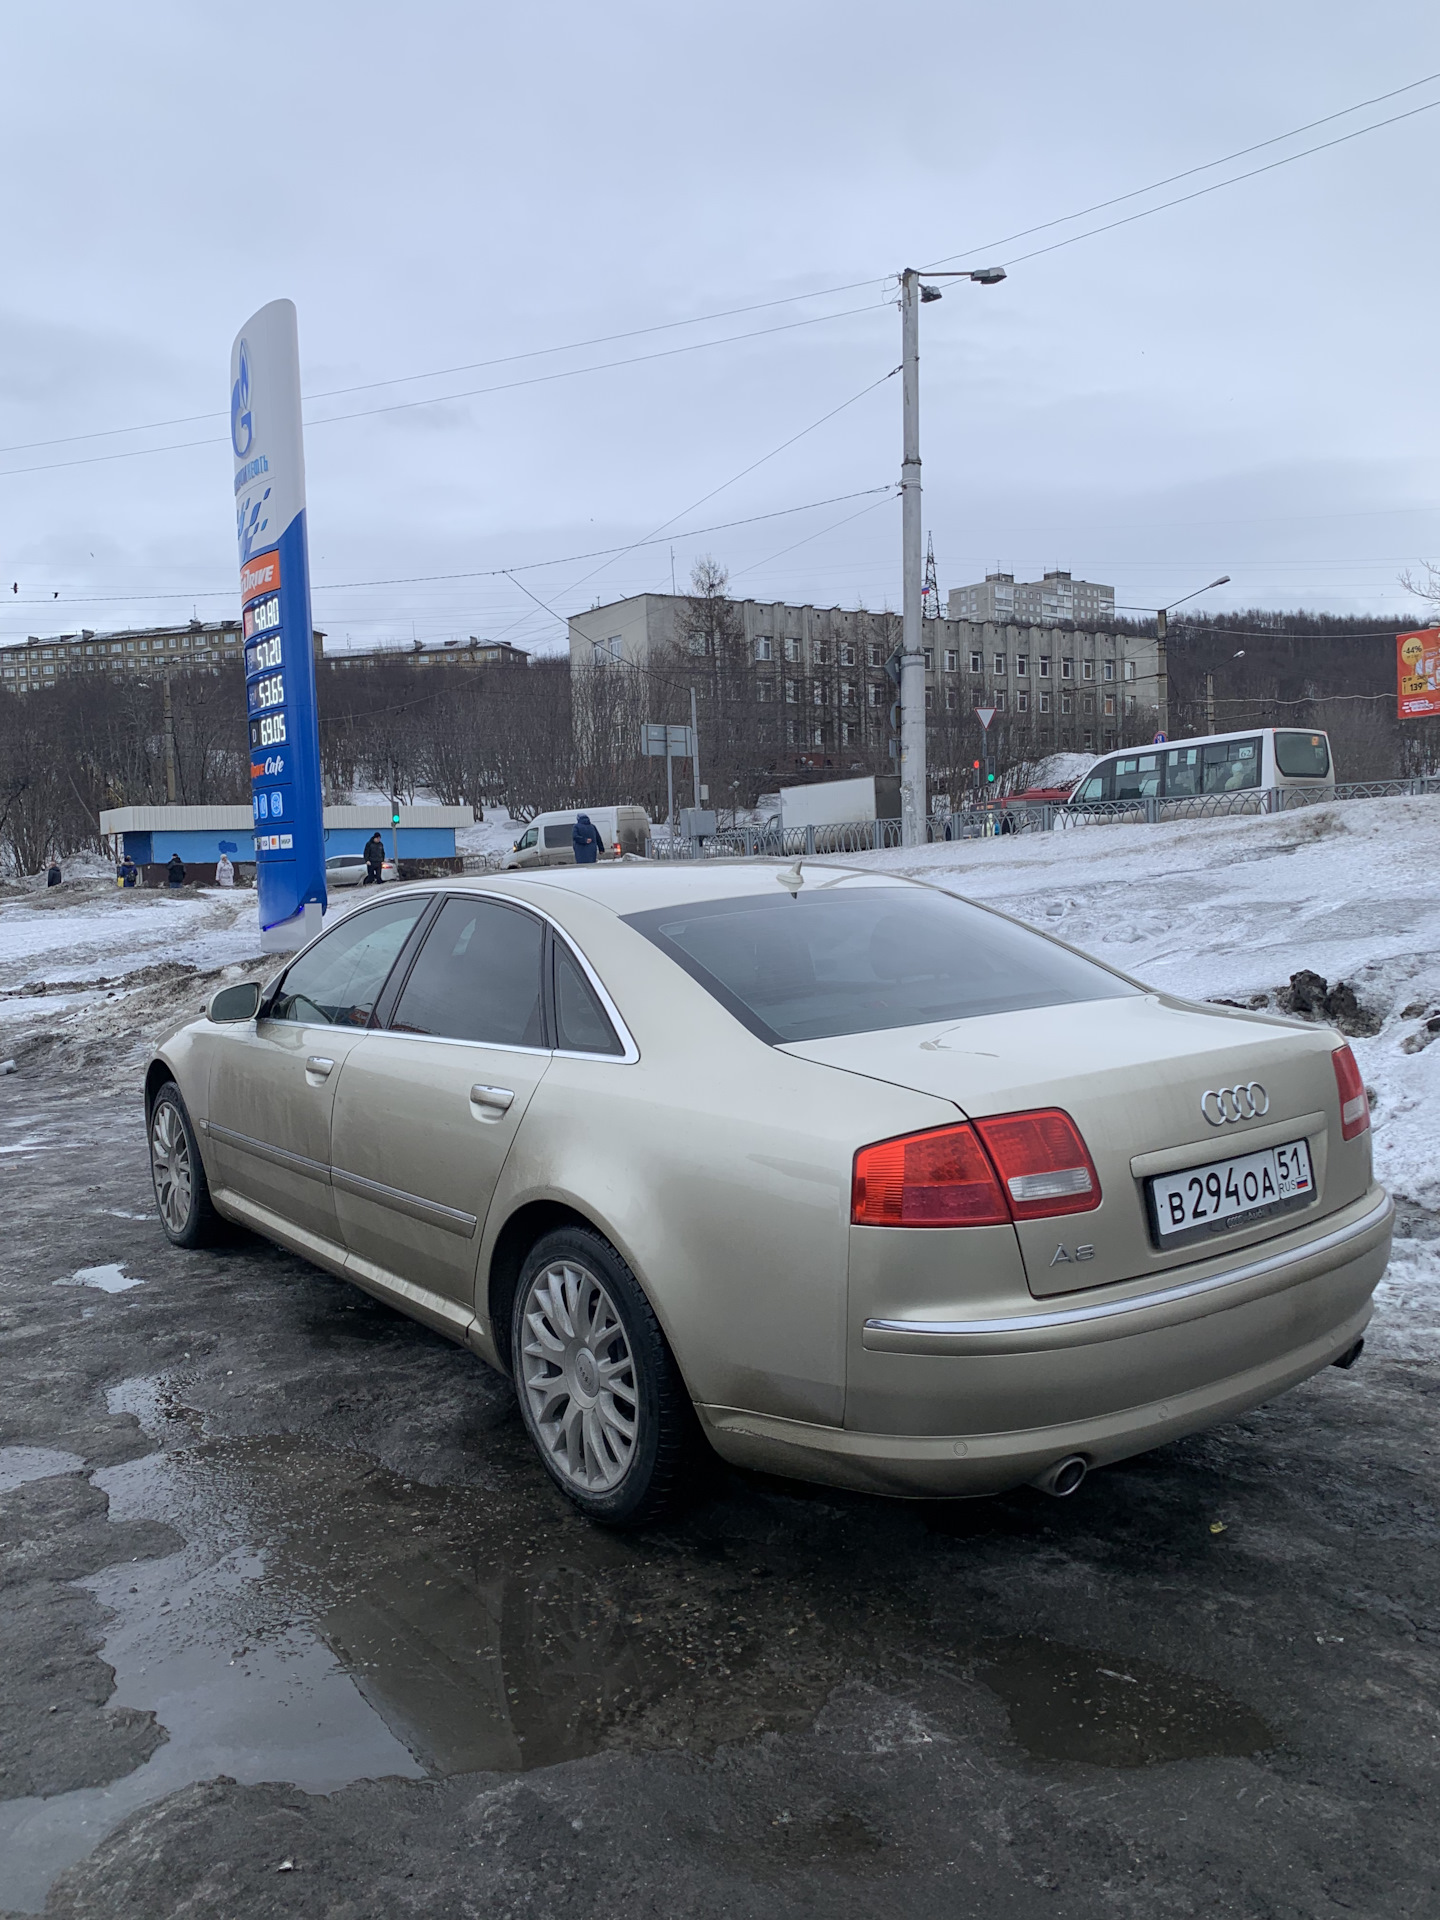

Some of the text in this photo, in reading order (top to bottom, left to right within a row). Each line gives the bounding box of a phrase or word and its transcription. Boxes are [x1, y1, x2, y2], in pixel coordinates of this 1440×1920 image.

[241, 565, 275, 595] DRIVE
[254, 597, 280, 631] 58.80
[256, 636, 282, 670] 57.20
[258, 674, 284, 708] 53.65
[260, 713, 286, 746] 69.05
[1277, 1147, 1302, 1180] 51
[1279, 1179, 1296, 1194] RUS
[1049, 1242, 1095, 1267] A8
